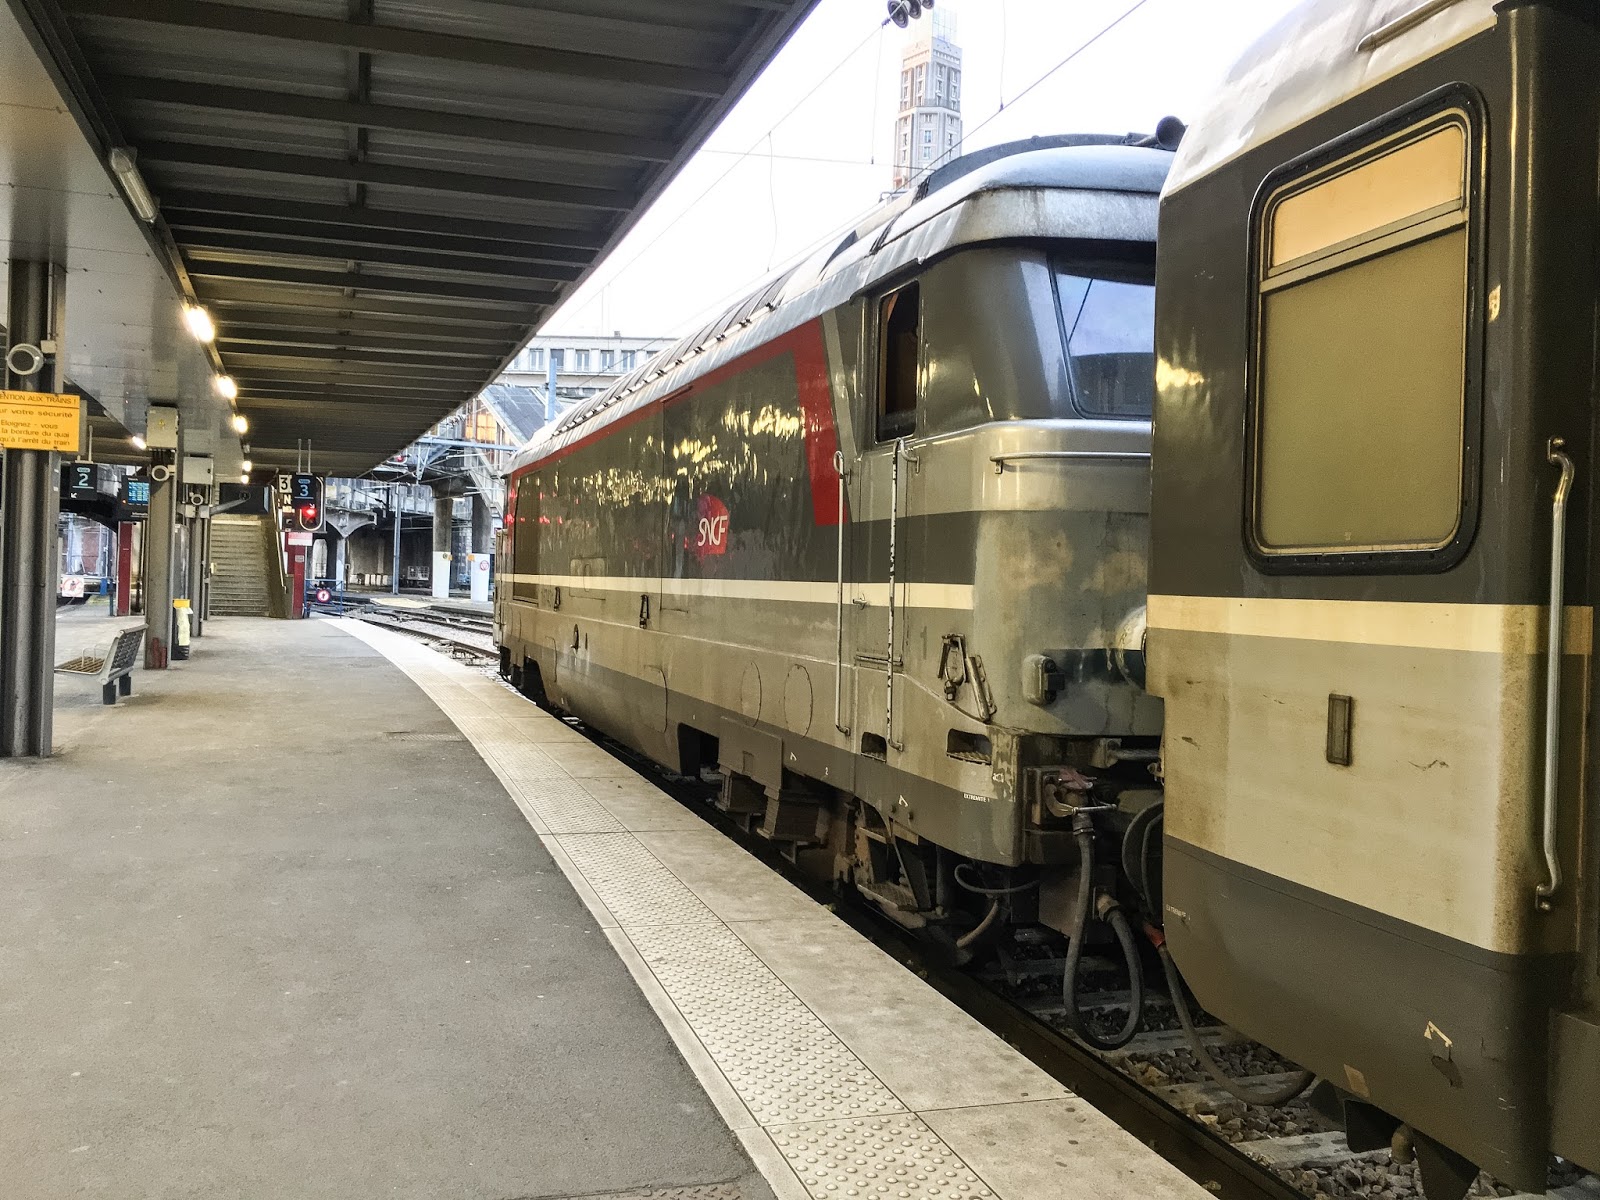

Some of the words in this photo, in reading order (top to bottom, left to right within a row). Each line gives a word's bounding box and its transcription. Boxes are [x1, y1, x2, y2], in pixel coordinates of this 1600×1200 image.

[46, 396, 71, 404] TRAINS
[11, 428, 39, 436] bordure
[78, 473, 89, 486] 2
[280, 477, 288, 490] 3
[300, 484, 309, 497] 3
[697, 515, 728, 547] SNCF
